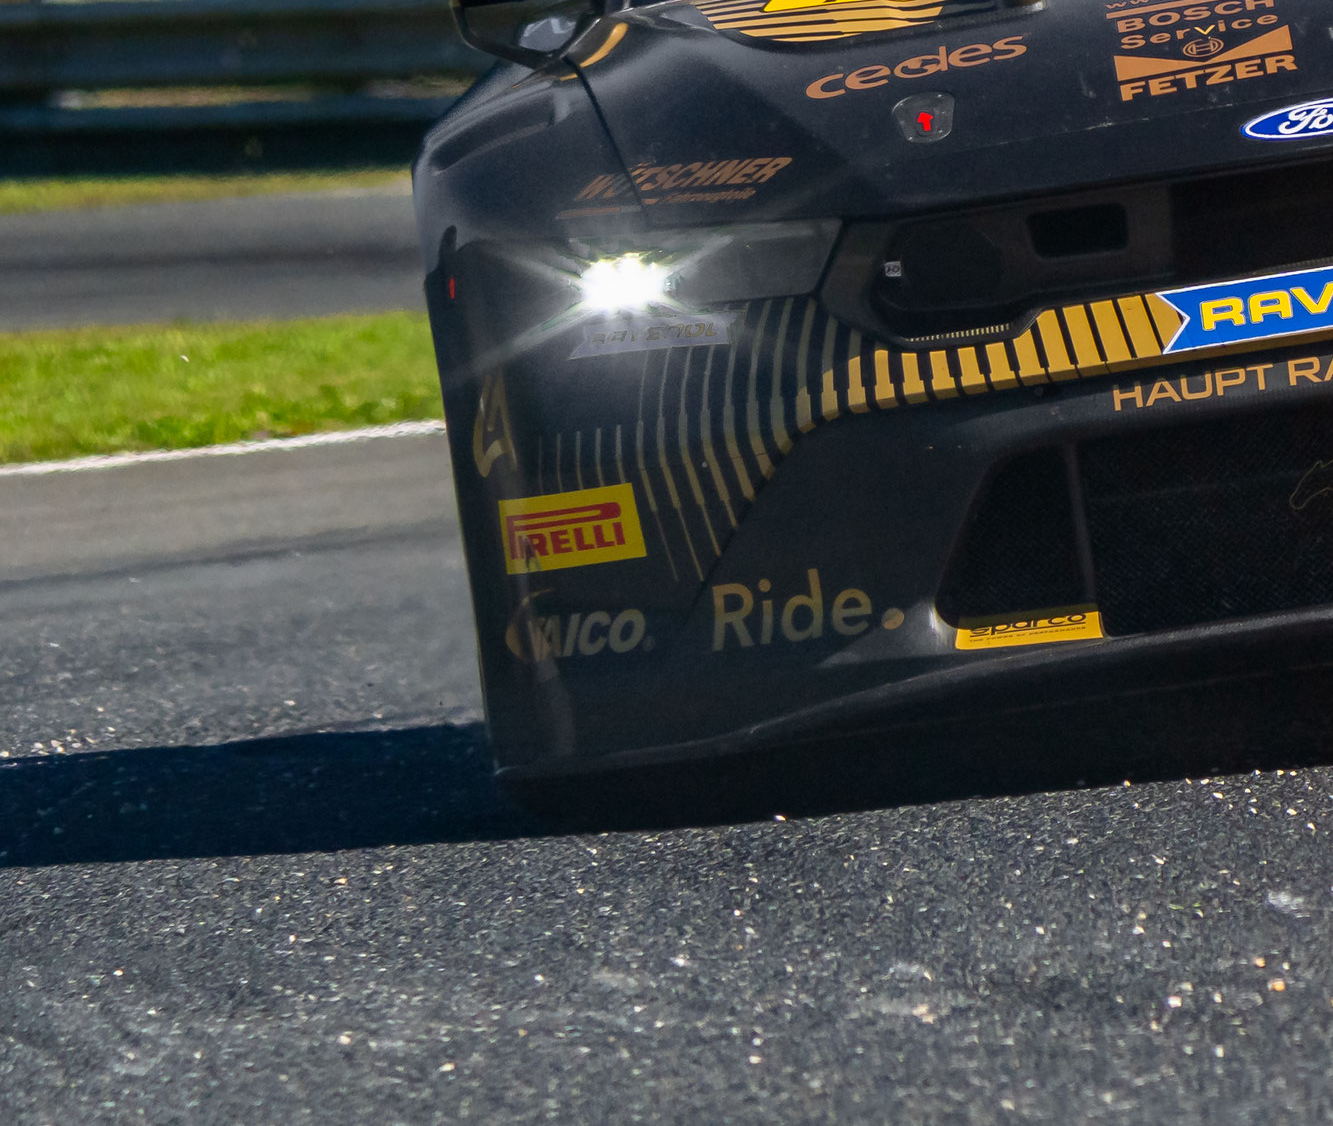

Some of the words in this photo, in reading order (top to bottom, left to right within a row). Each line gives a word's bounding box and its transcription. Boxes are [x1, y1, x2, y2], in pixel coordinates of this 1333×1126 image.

[1120, 14, 1279, 50] Service
[805, 36, 1028, 100] cedes
[1120, 54, 1298, 102] FETZER
[1113, 363, 1273, 412] HAUPT
[506, 501, 626, 561] PIRELLI
[712, 568, 905, 652] Ride.
[969, 613, 1087, 638] sparco
